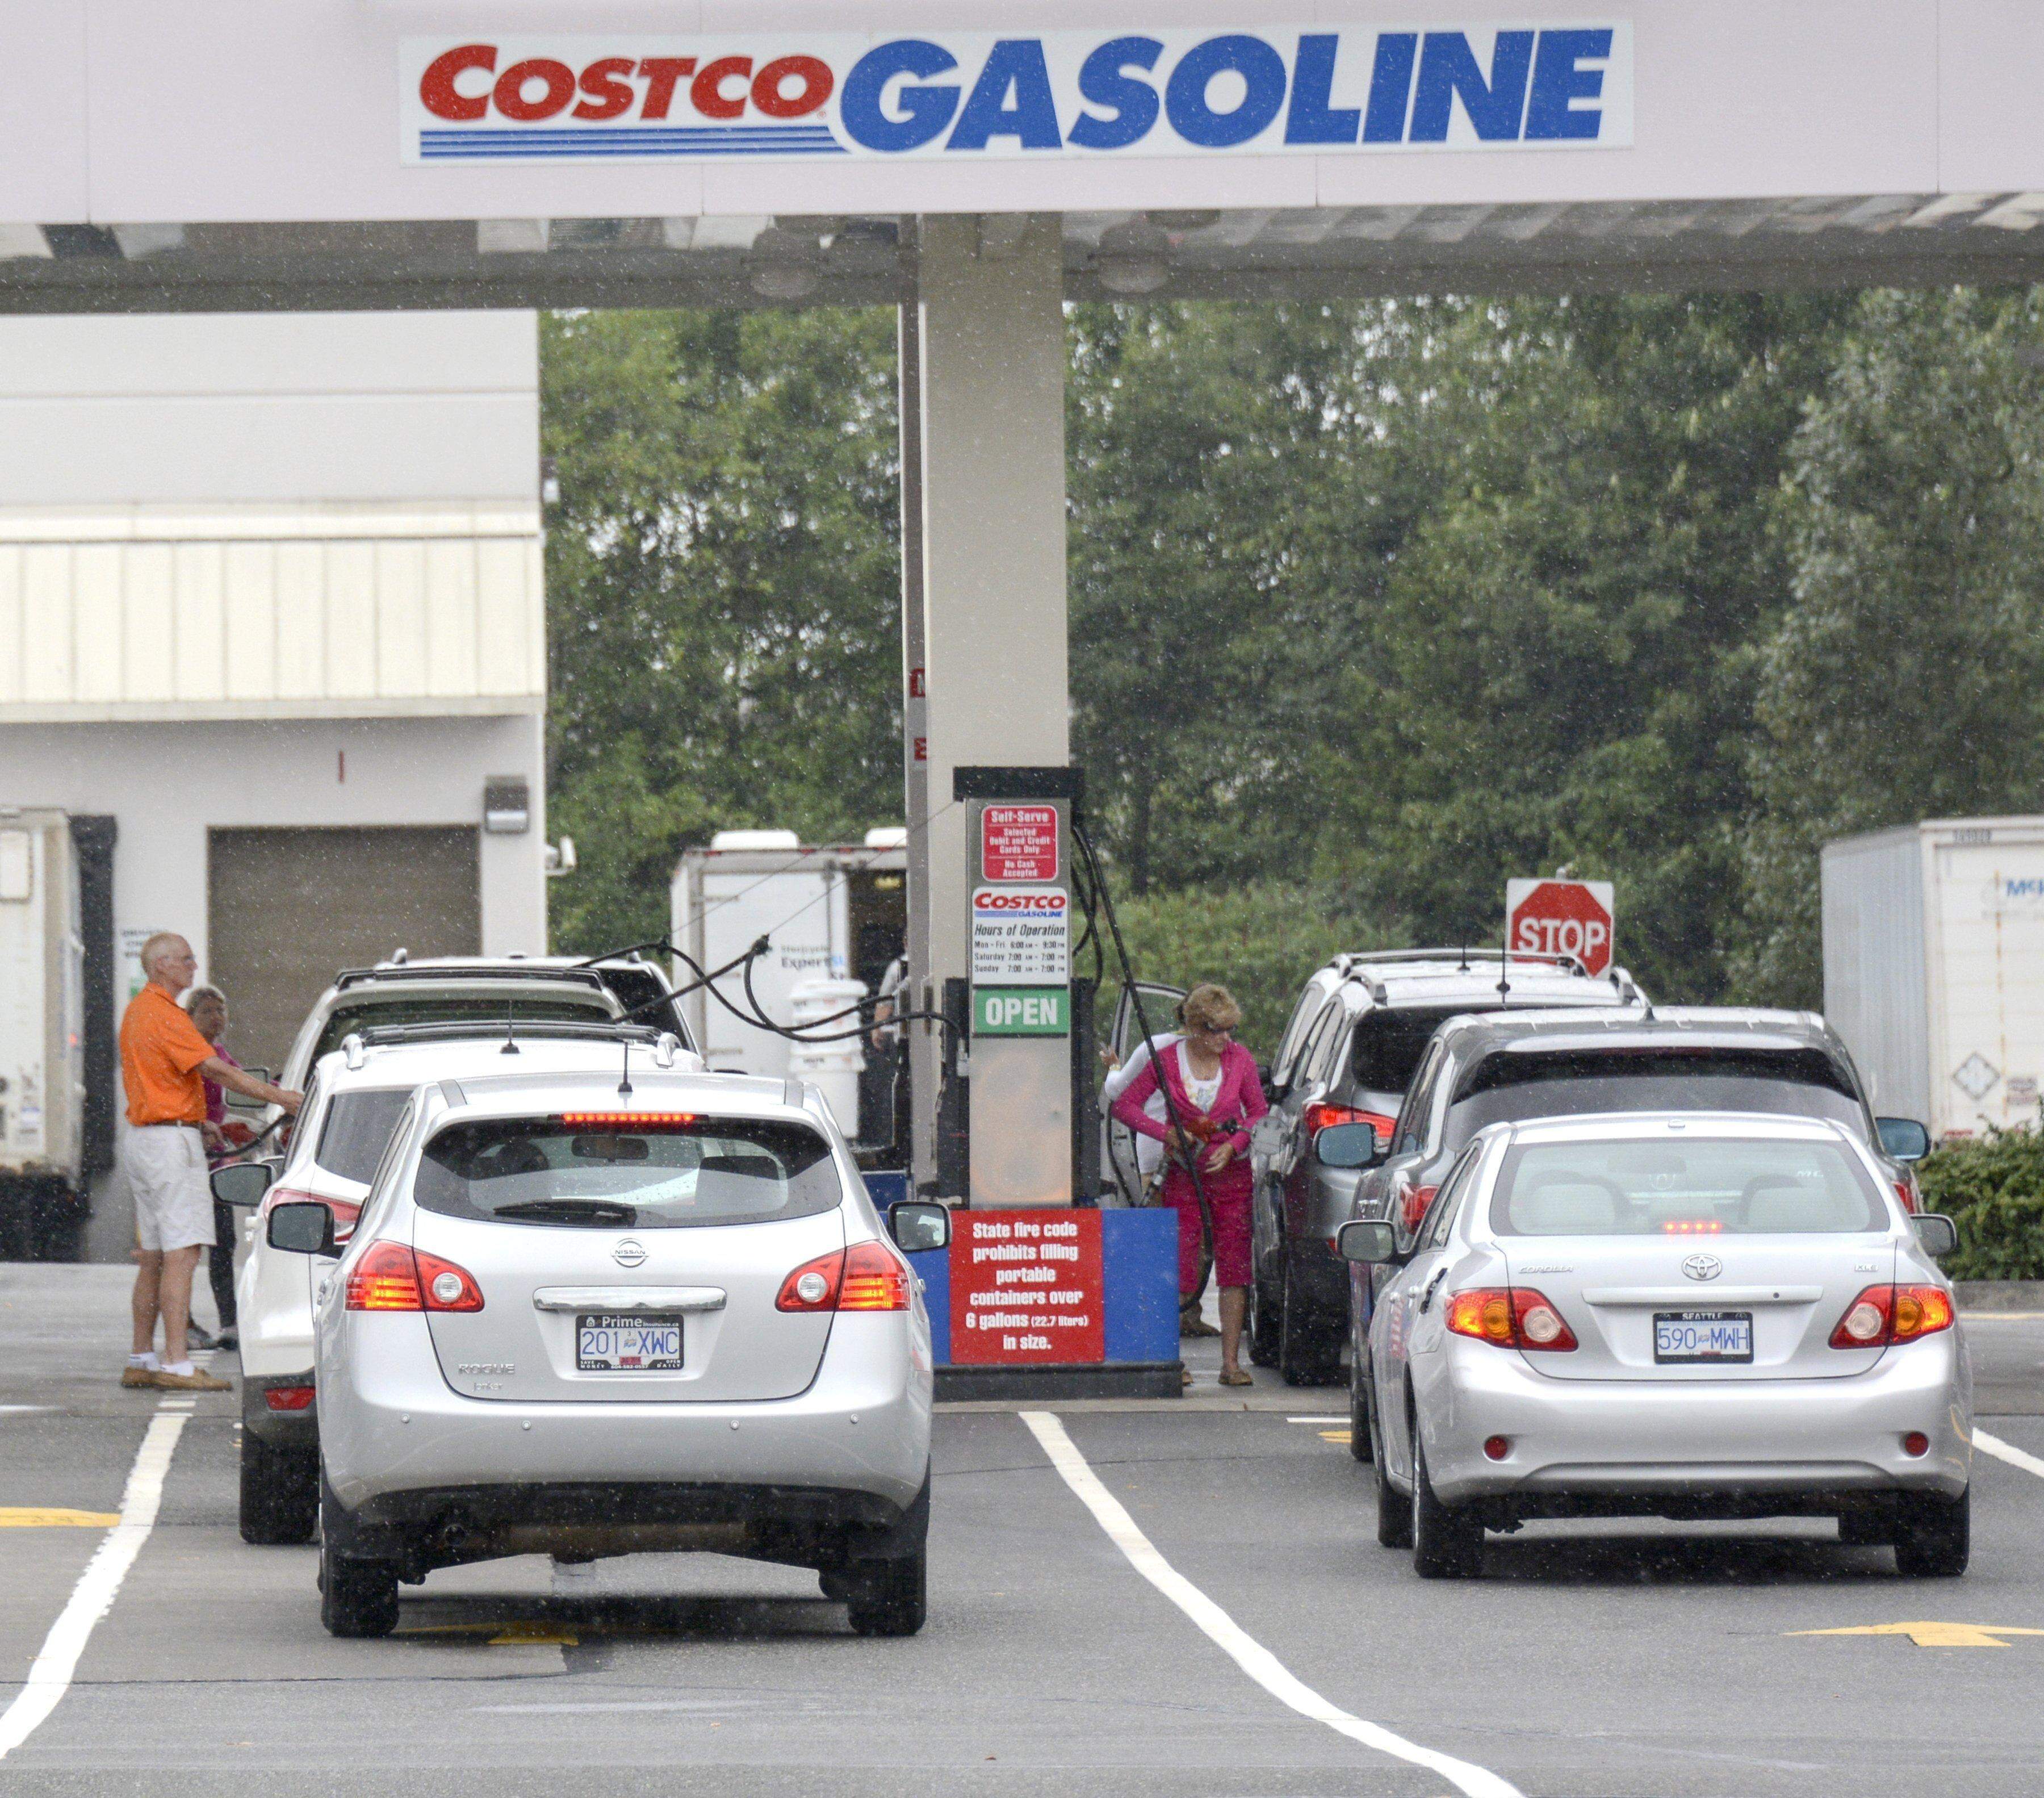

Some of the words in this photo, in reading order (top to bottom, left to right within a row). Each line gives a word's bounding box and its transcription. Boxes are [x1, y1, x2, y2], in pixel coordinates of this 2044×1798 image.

[420, 45, 835, 121] COSTCO
[839, 28, 1614, 152] GASOLINE
[991, 810, 1049, 822] Self-Serve
[1003, 827, 1037, 837] Selected
[989, 836, 1010, 846] Debit
[1011, 837, 1025, 845] and
[1027, 836, 1050, 845] Credit
[999, 845, 1021, 854] Cards
[1023, 845, 1040, 855] Only
[1004, 860, 1015, 868] No
[1017, 860, 1035, 868] Cash
[1003, 869, 1038, 878] Accepted
[974, 893, 1066, 909] COSTCO
[975, 924, 1002, 935] Hours
[1007, 924, 1017, 935] of
[1020, 924, 1065, 936] Operation
[1518, 917, 1606, 957] STOP
[985, 998, 1057, 1026] OPEN
[973, 1223, 1011, 1239] State
[1014, 1222, 1040, 1237] fire
[1044, 1221, 1078, 1237] code
[973, 1244, 1036, 1263] prohibits
[1040, 1243, 1079, 1261] filling
[996, 1266, 1056, 1285] portable
[1518, 1265, 1573, 1274] COROLLA
[970, 1290, 1046, 1306] containers
[1049, 1291, 1083, 1304] over
[602, 1315, 642, 1327] Prime
[966, 1312, 976, 1328] 6
[979, 1312, 1029, 1330] gallons
[1031, 1315, 1056, 1327] (22.7
[1058, 1315, 1088, 1327] liters)
[582, 1331, 618, 1354] 201
[638, 1331, 678, 1354] XWC
[1003, 1335, 1016, 1350] in
[1020, 1335, 1052, 1349] size.
[1658, 1327, 1697, 1350] 590
[1710, 1327, 1749, 1349] MWH
[458, 1364, 516, 1374] ROGUE
